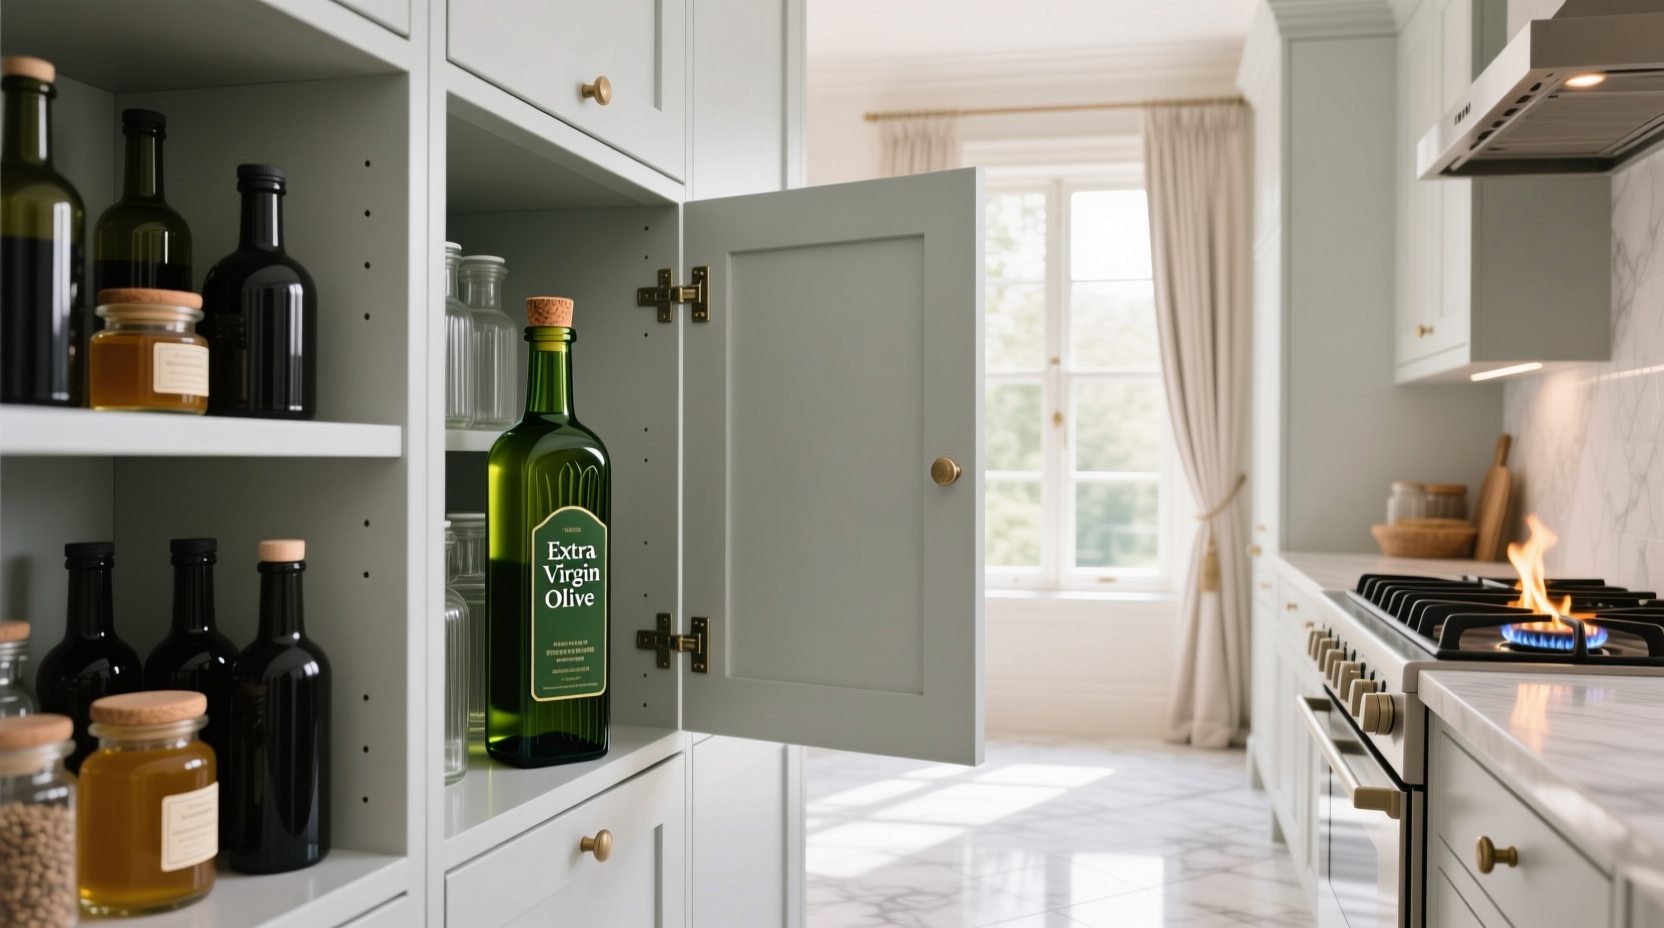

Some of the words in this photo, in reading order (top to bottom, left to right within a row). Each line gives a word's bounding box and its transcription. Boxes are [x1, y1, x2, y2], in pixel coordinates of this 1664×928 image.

[547, 541, 597, 561] Extra
[543, 563, 600, 588] Virgin
[545, 587, 595, 609] Olive
